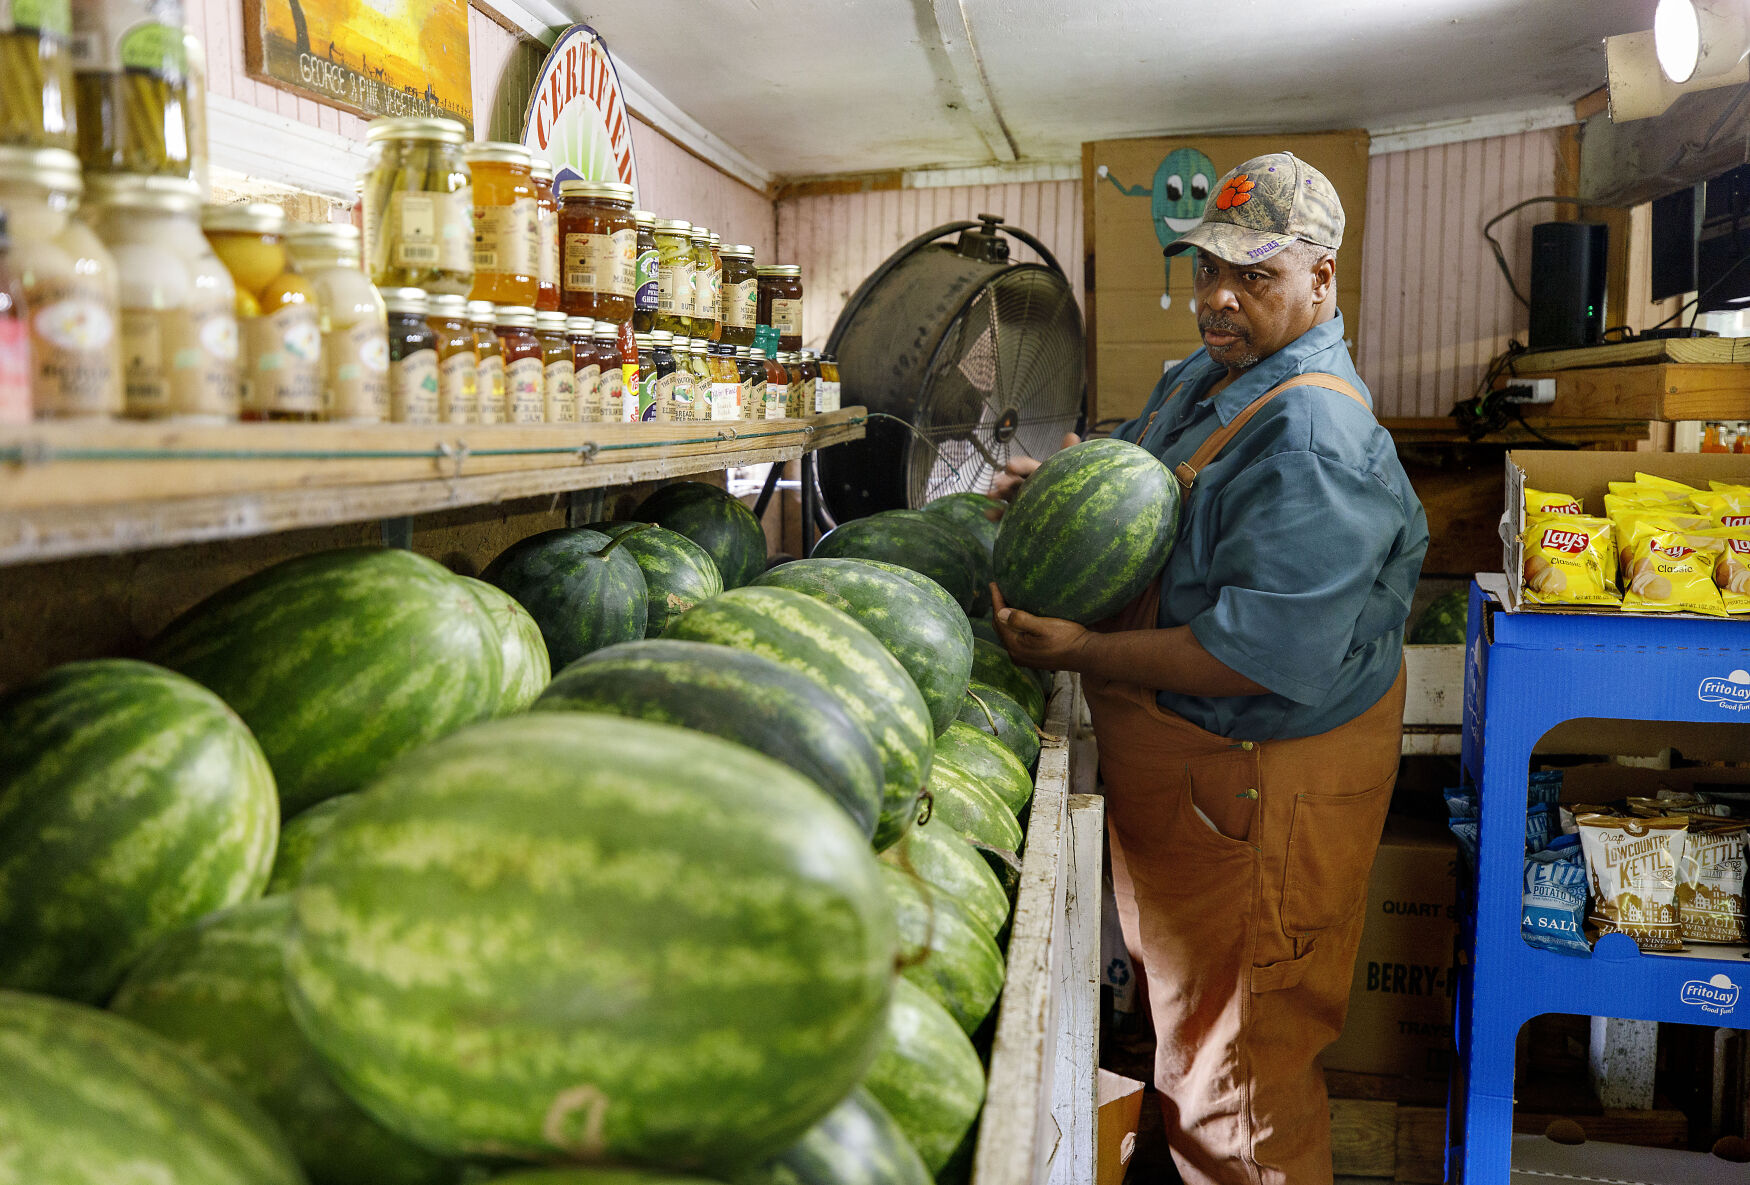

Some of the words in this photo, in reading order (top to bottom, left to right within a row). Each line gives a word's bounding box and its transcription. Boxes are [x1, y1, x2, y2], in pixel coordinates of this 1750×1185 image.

[300, 52, 346, 95] GEORGE
[1247, 240, 1279, 258] TIGERS
[1543, 529, 1588, 552] Lay's
[1657, 564, 1693, 573] Classic
[1720, 702, 1737, 711] Good
[1599, 832, 1625, 844] Craft
[1605, 835, 1671, 868] LOWCOUNTRY
[1533, 884, 1566, 900] POTATO
[1382, 900, 1443, 918] QUART
[1538, 917, 1579, 932] SALT
[1690, 930, 1708, 938] SEA
[1710, 933, 1734, 941] SALT
[1701, 1004, 1719, 1014] Good
